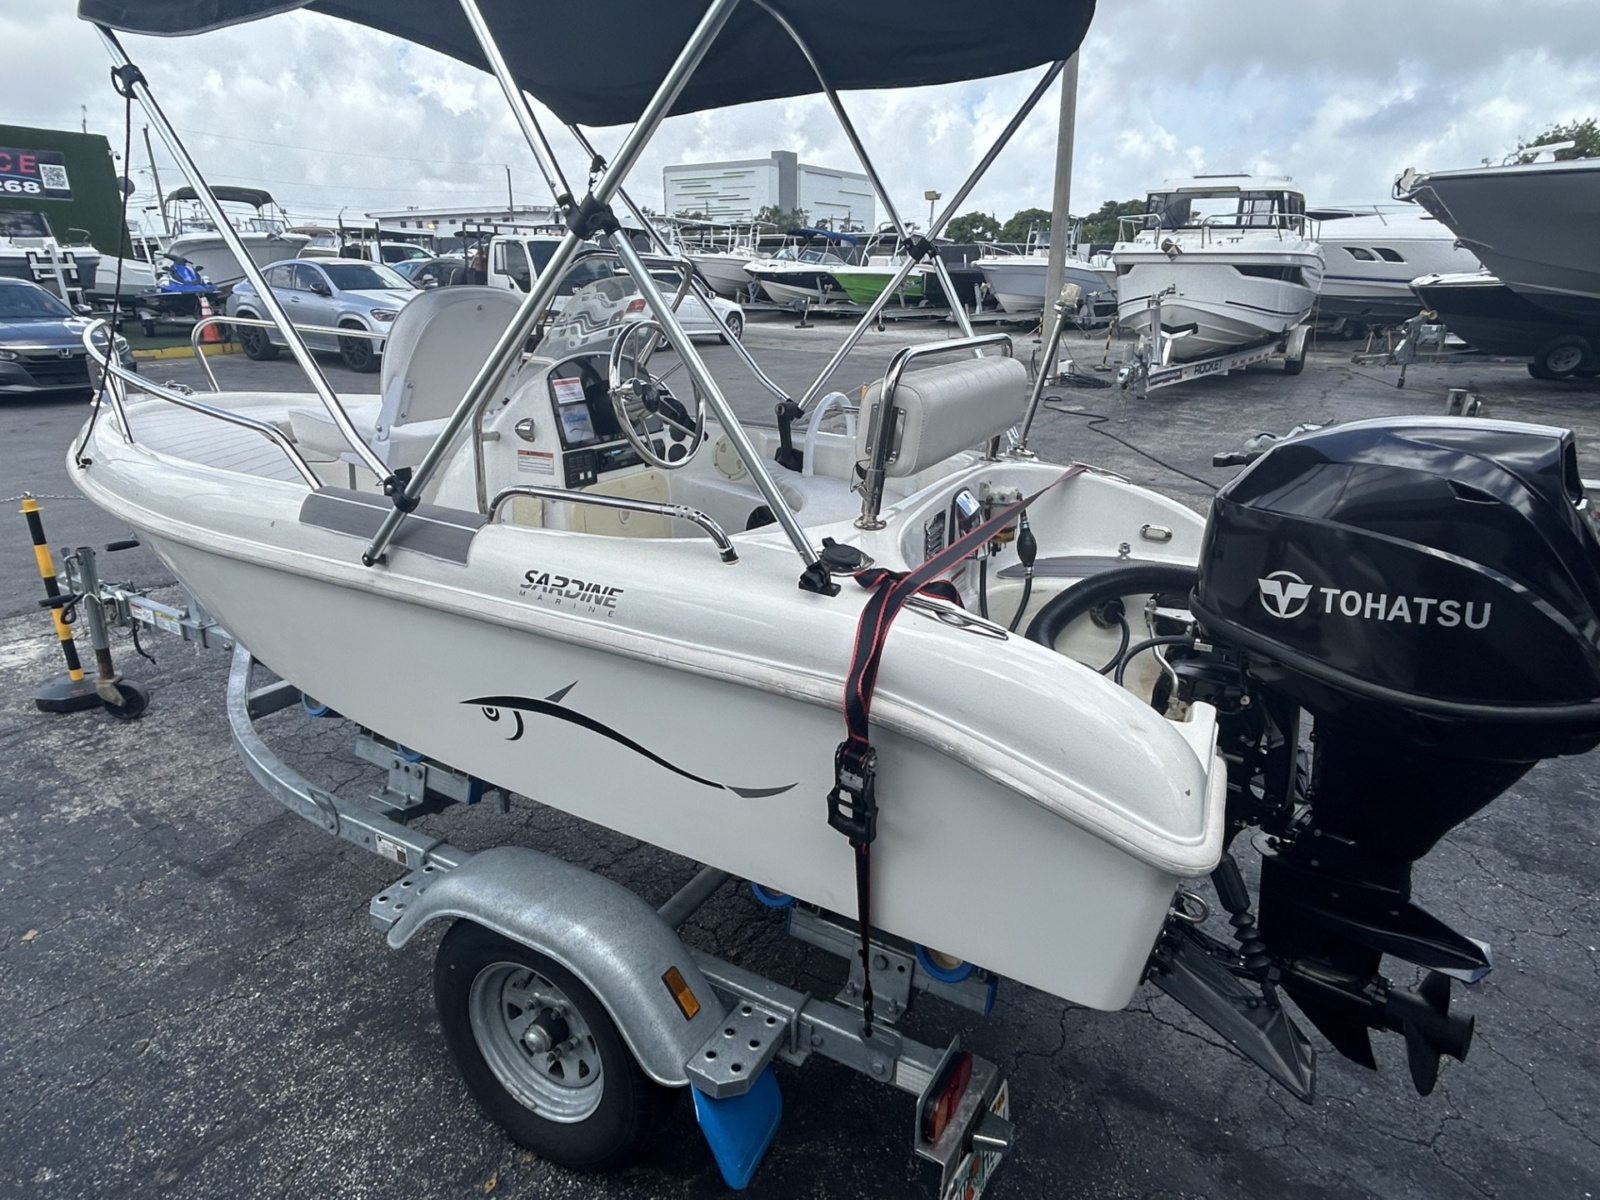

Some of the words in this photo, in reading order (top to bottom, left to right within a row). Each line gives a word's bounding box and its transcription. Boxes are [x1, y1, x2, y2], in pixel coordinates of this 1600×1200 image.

[0, 180, 41, 193] 68
[1194, 359, 1223, 375] ROCKET
[520, 569, 624, 608] SARDINE
[518, 589, 615, 618] MARINE
[1319, 587, 1492, 630] TOHATSU
